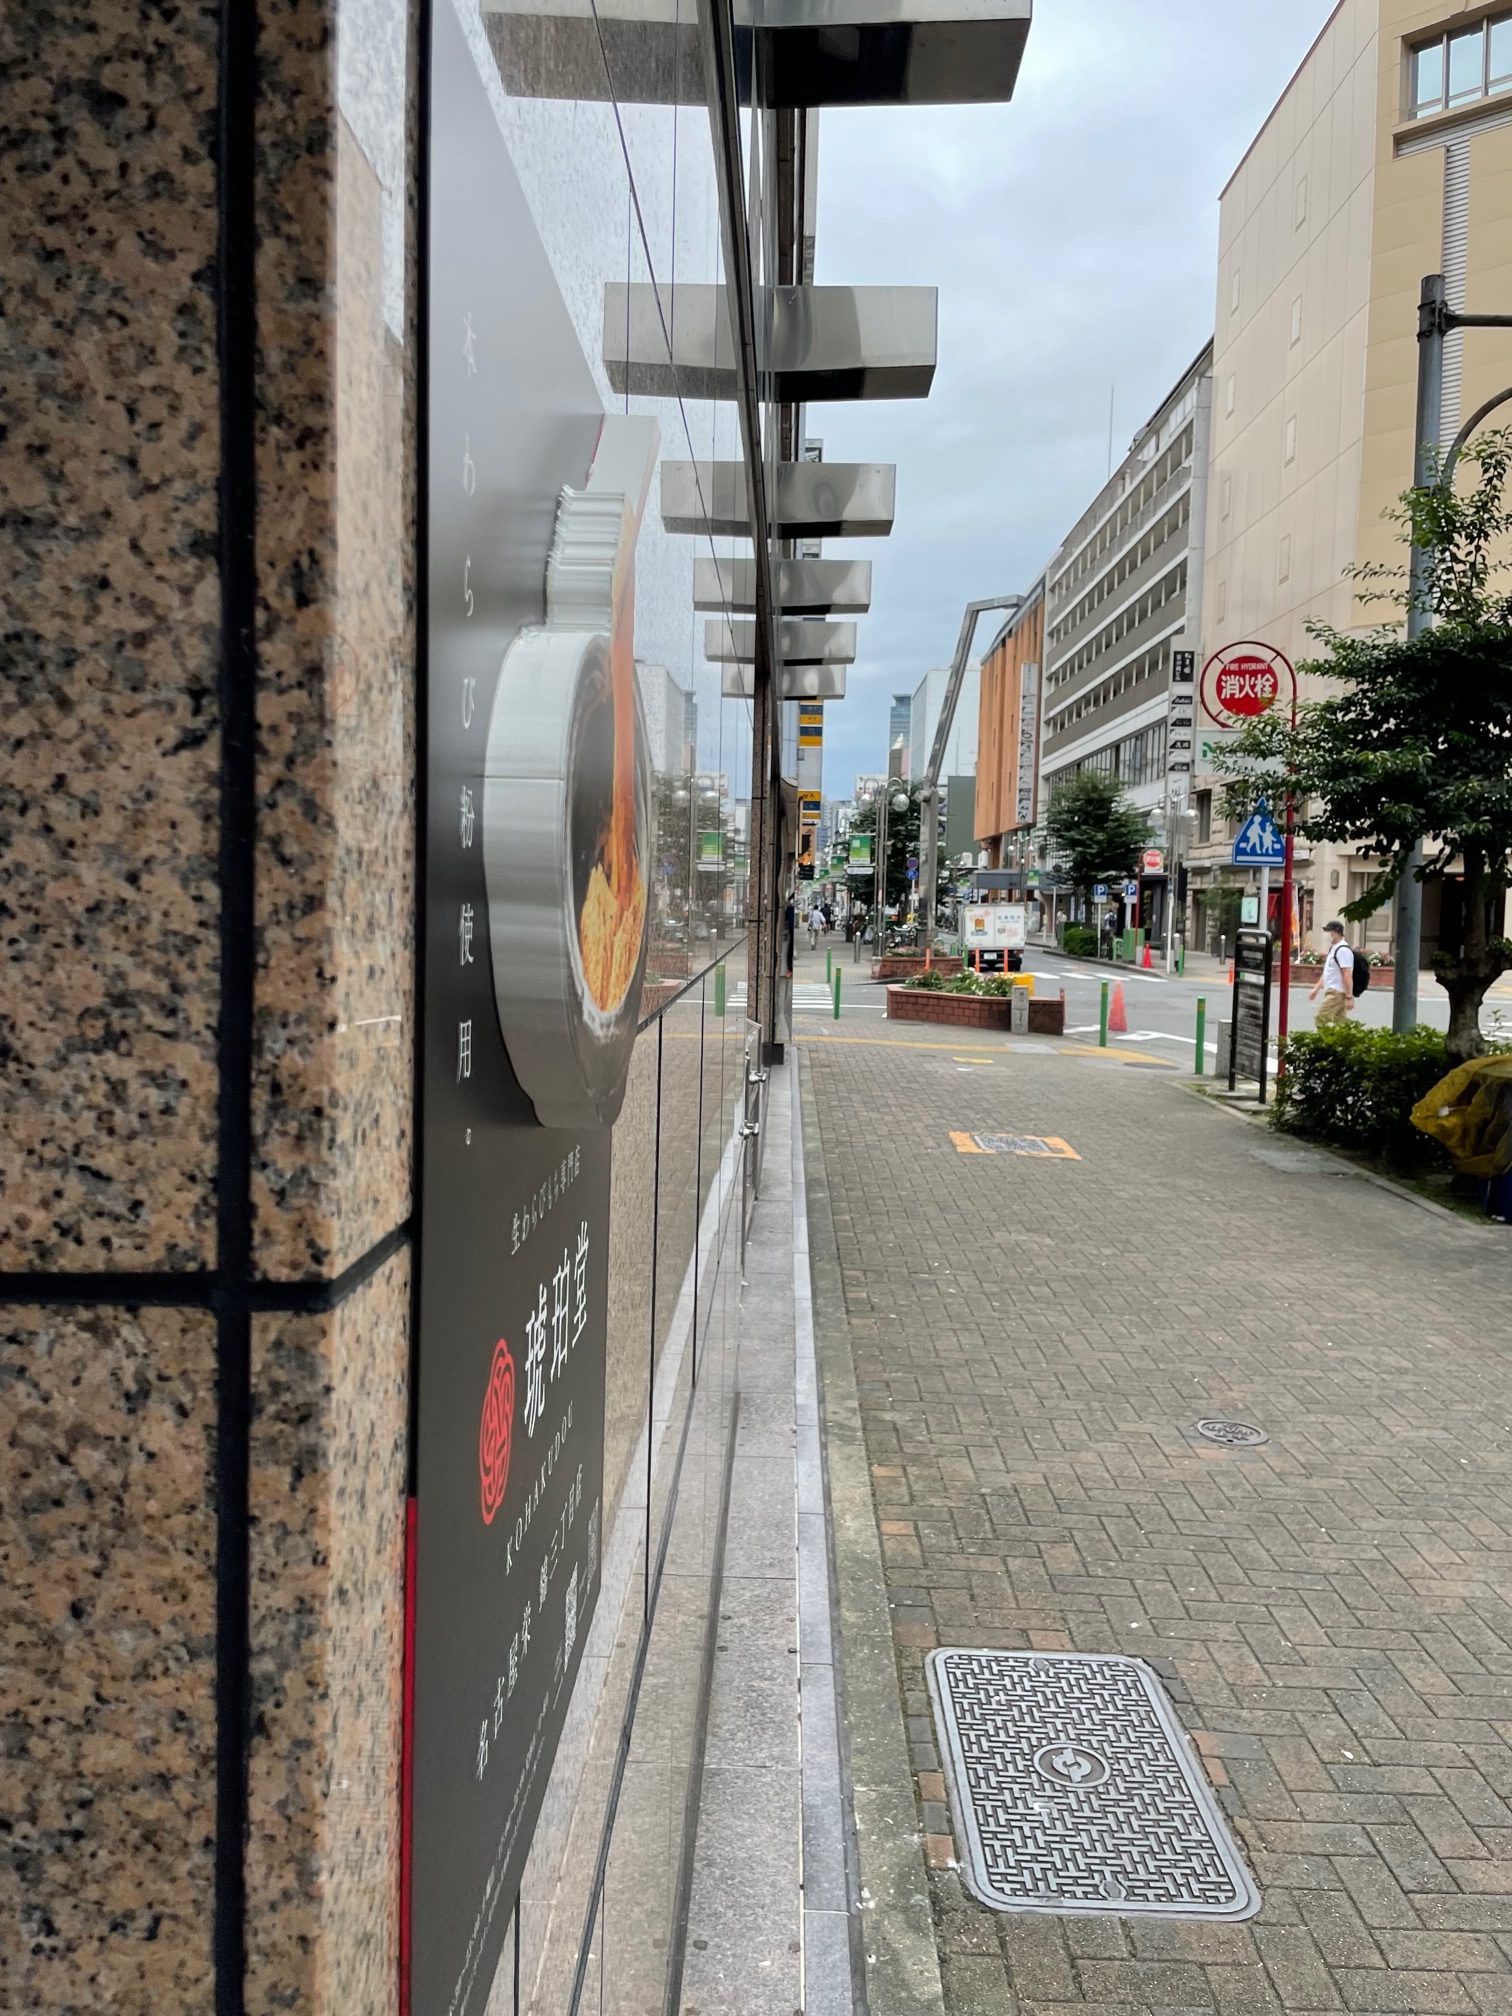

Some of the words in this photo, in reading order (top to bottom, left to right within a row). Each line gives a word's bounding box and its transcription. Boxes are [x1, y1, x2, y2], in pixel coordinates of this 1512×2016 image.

[1220, 673, 1275, 699] 消火栓
[1225, 662, 1240, 671] FIRE
[1241, 662, 1269, 671] HYDRANT
[523, 1220, 589, 1438] 琥珀堂
[505, 1400, 574, 1577] KOHAKUDOU
